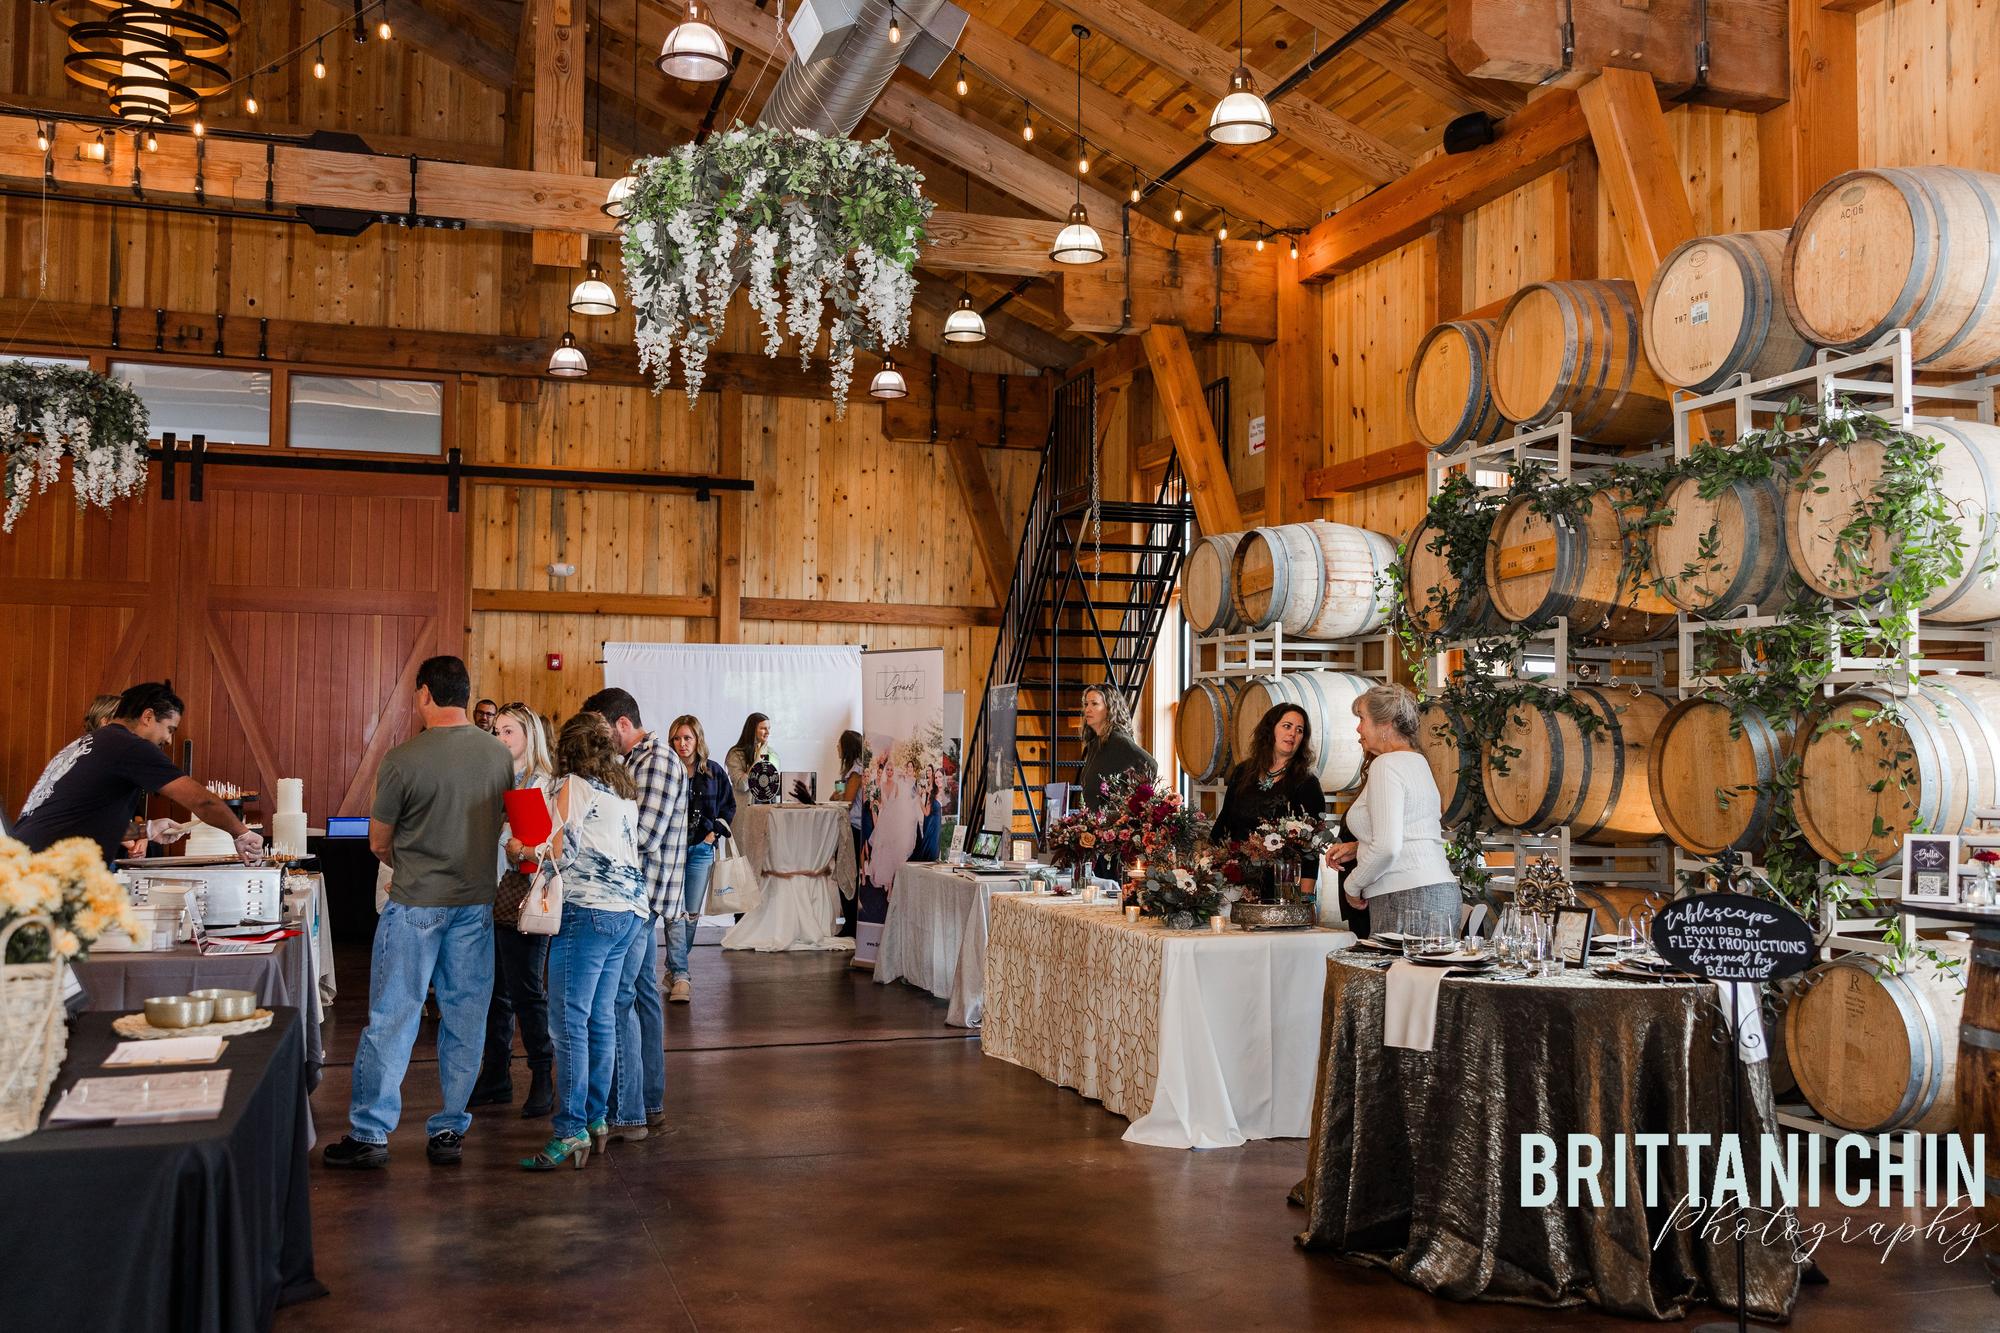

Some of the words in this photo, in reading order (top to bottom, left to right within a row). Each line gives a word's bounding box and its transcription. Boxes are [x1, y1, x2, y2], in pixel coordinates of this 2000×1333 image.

[1917, 848, 1939, 861] Bella
[1664, 901, 1778, 930] tablescape
[1683, 926, 1742, 936] PROVIDED
[1745, 928, 1761, 938] BY
[1668, 937, 1717, 949] FLEXX
[1719, 938, 1807, 954] PRODUCTIONS
[1689, 949, 1751, 967] designed
[1754, 952, 1778, 971] by
